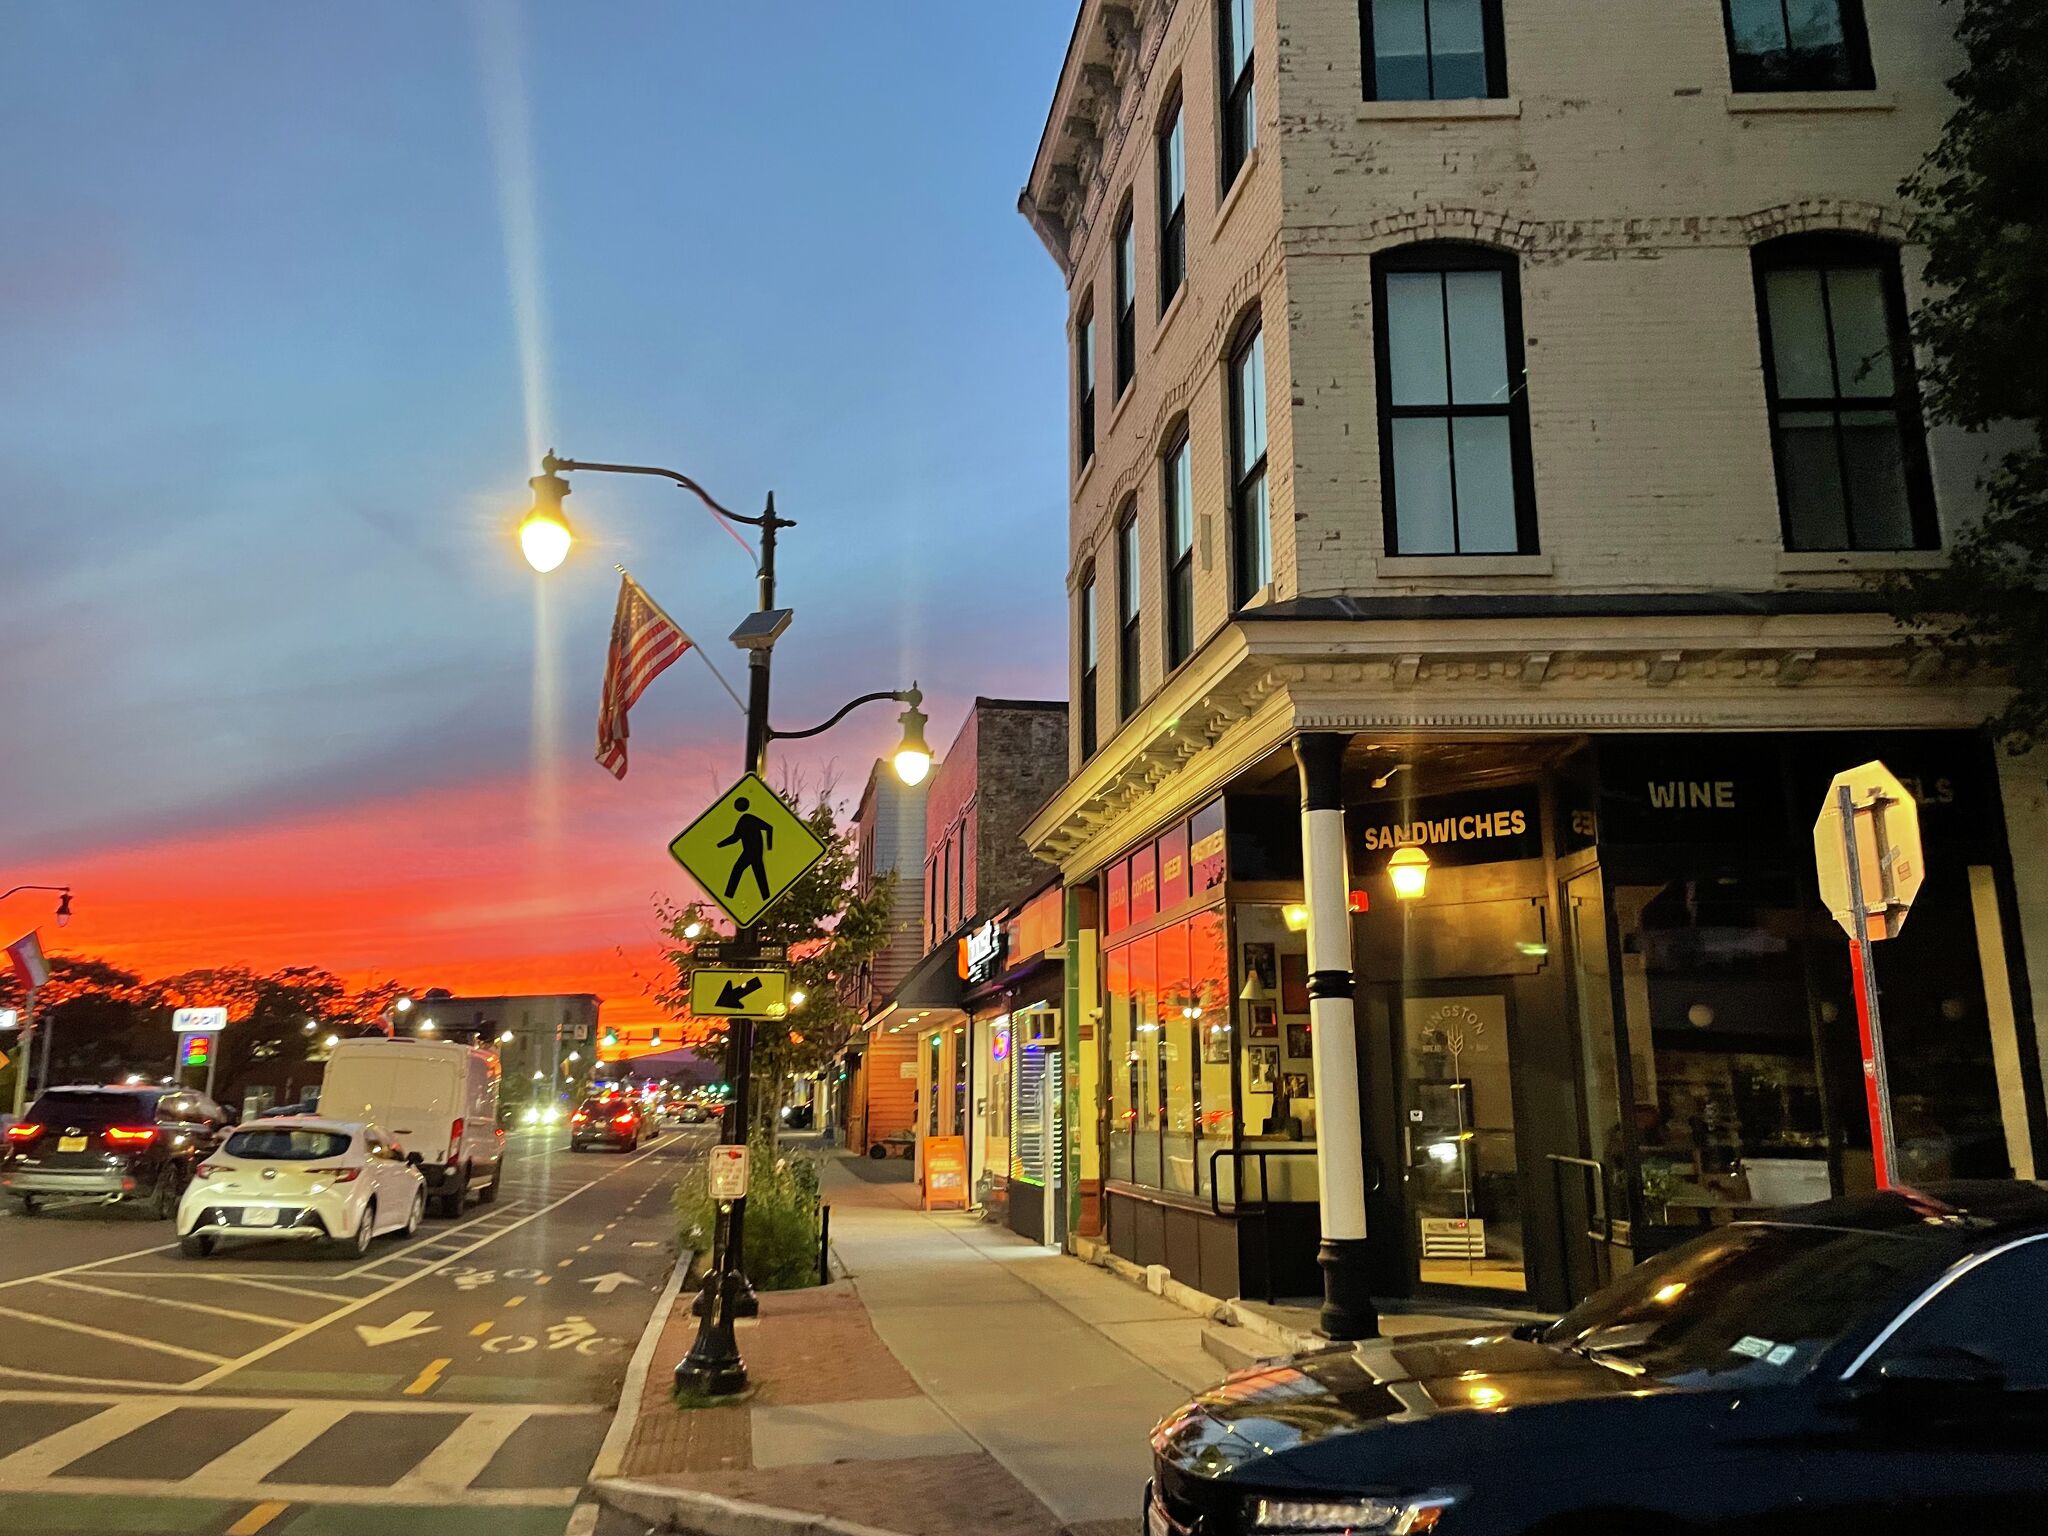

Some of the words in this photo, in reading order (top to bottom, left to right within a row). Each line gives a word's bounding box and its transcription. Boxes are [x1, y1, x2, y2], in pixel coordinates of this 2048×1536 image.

[1648, 781, 1735, 808] WINE
[1365, 810, 1526, 850] SANDWICHES
[1163, 855, 1182, 883] BEER
[180, 1012, 221, 1026] Mobil
[1422, 1005, 1485, 1036] KINGSTON
